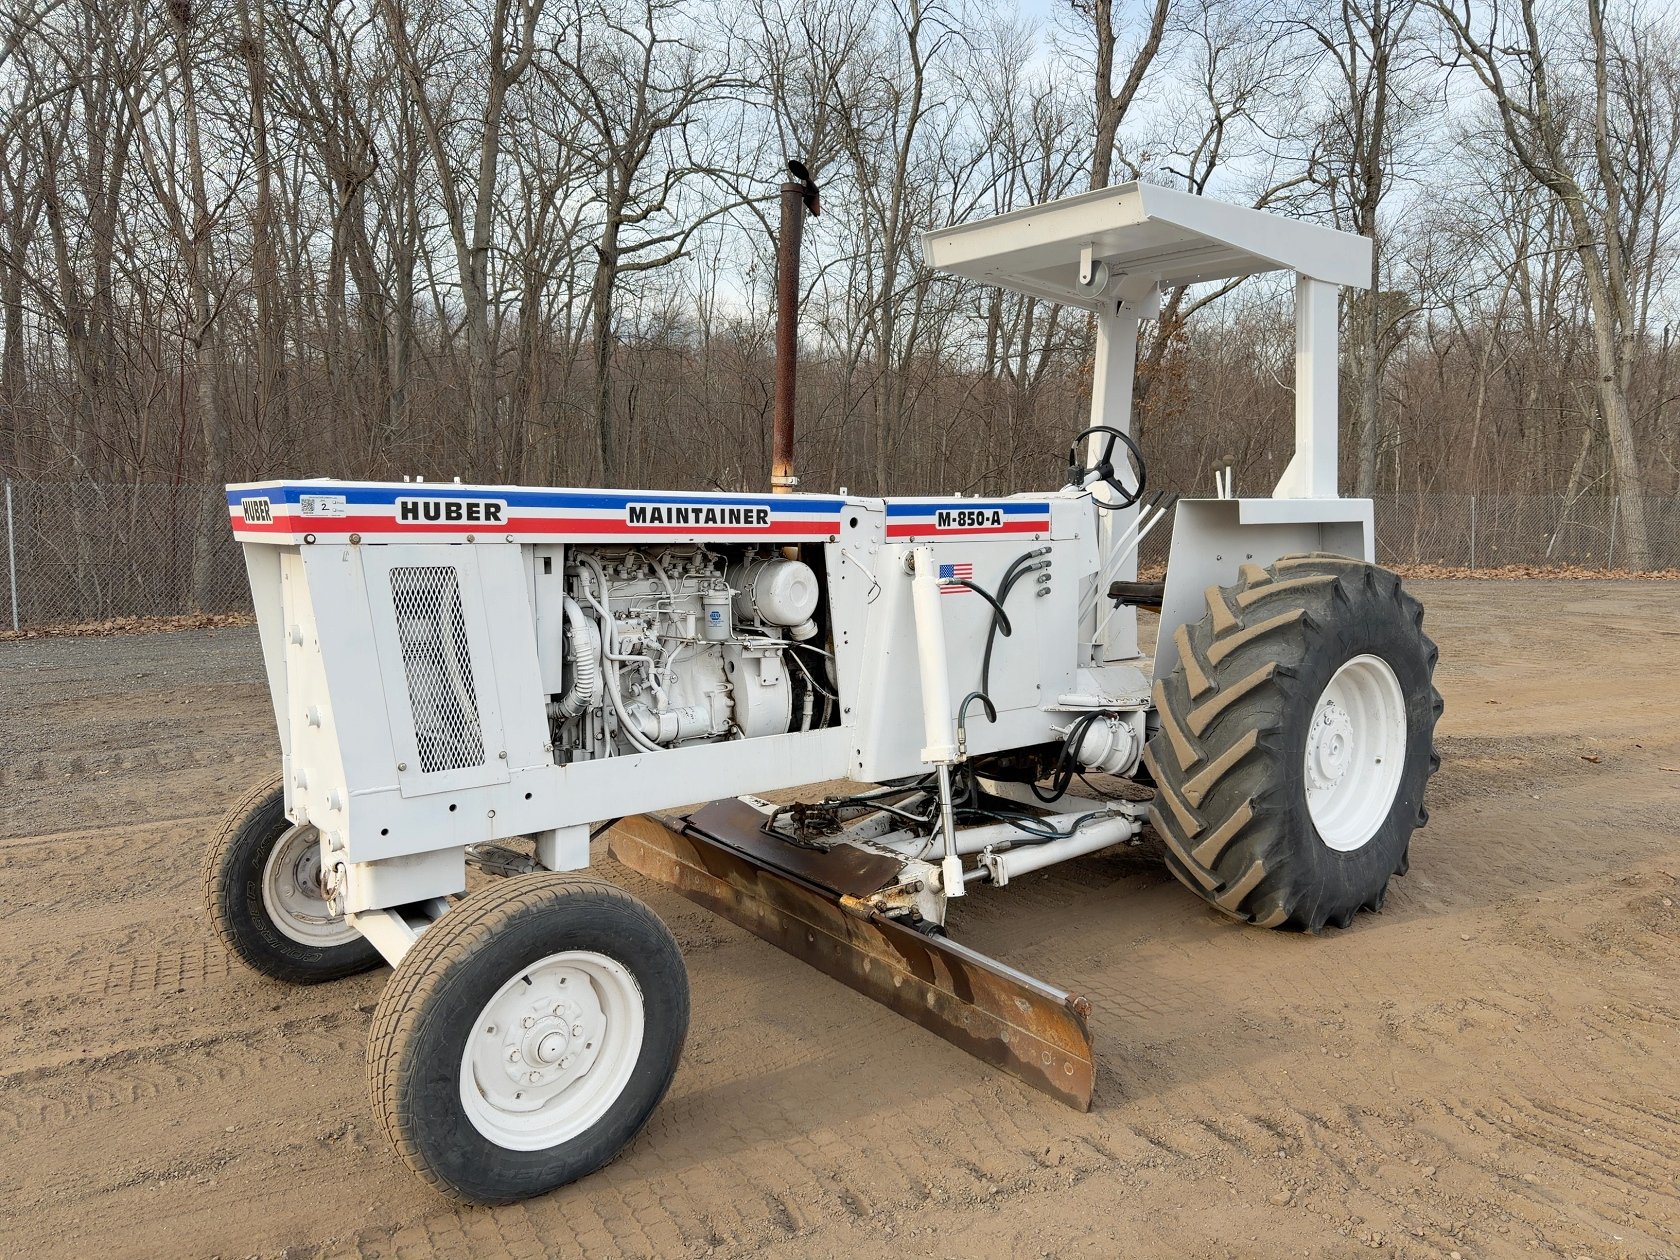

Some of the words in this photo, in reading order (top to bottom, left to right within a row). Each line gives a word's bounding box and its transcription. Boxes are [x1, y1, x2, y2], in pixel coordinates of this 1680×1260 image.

[242, 500, 272, 522] HUBER
[321, 503, 330, 511] 2
[401, 501, 502, 522] HUBER
[629, 506, 769, 525] MAINTAINER
[938, 510, 1001, 527] M-850-A
